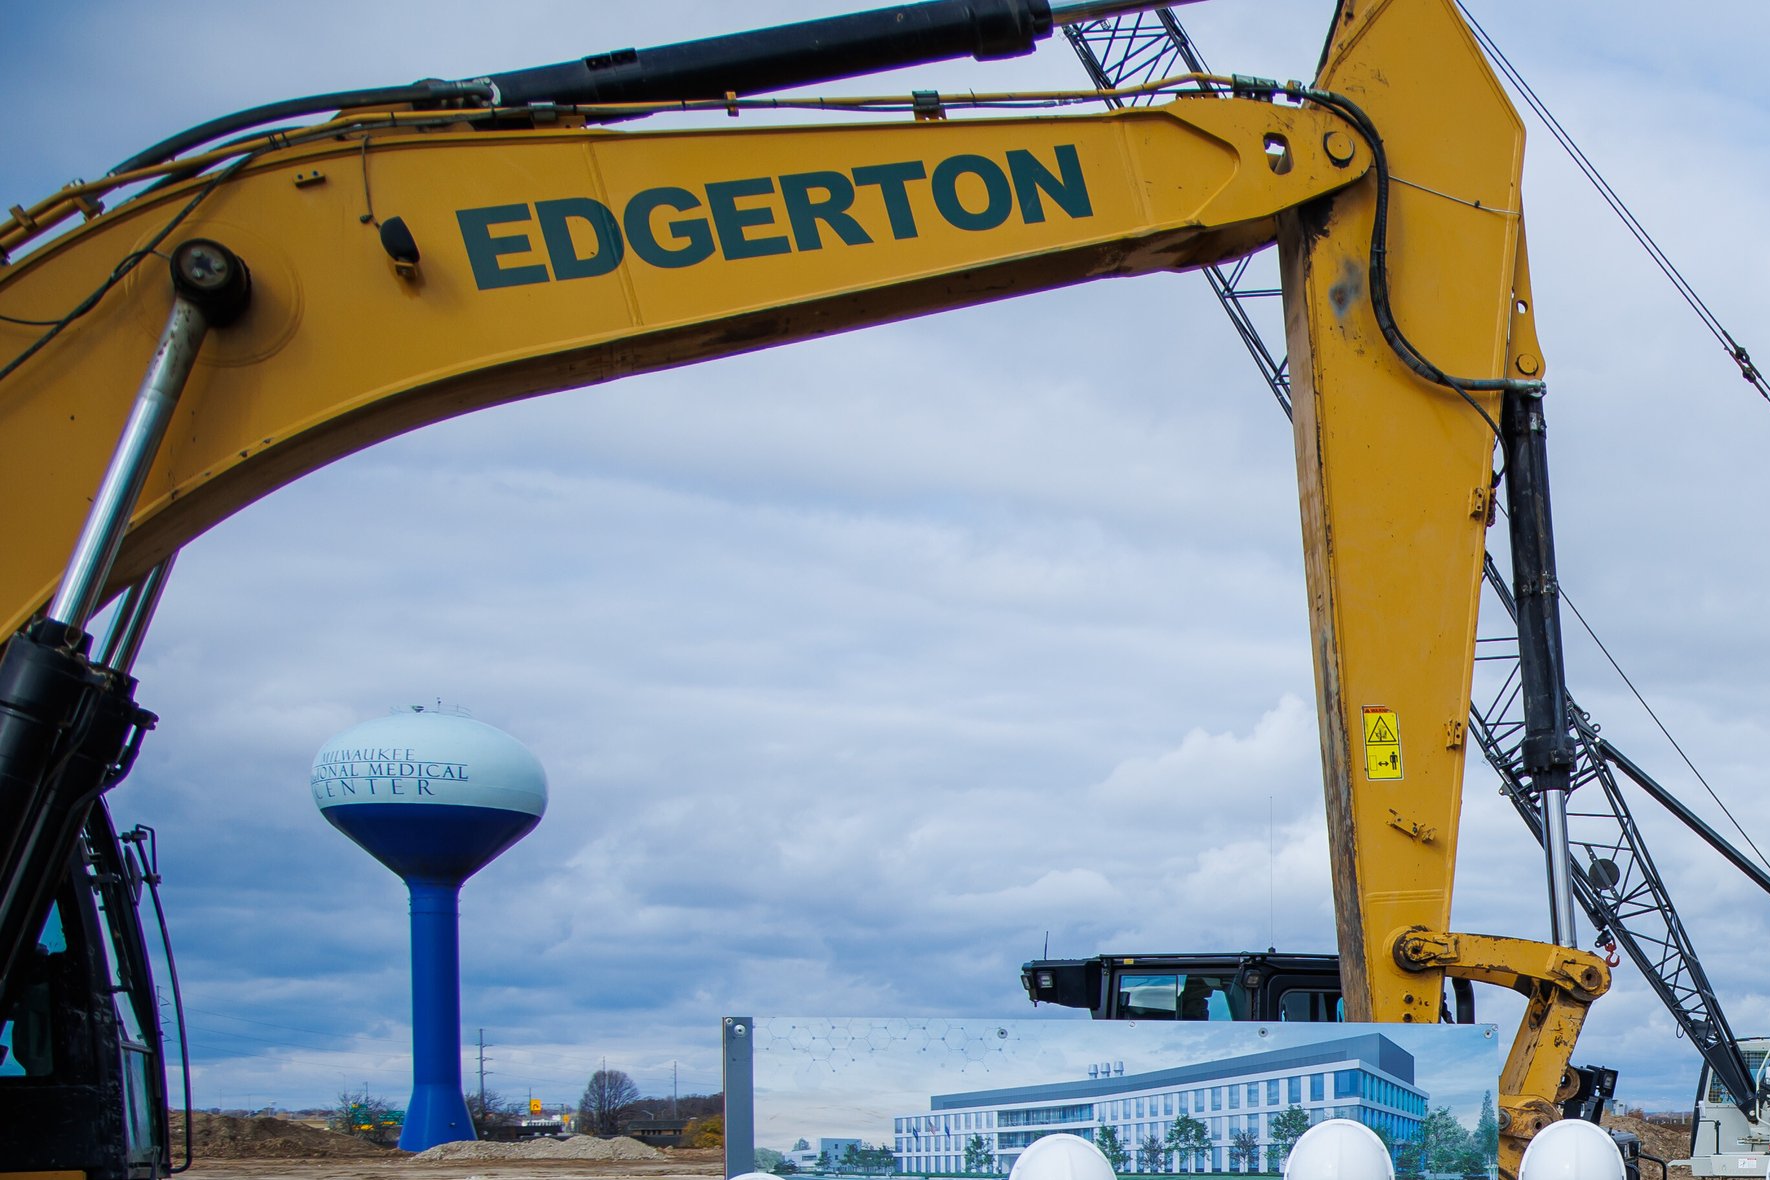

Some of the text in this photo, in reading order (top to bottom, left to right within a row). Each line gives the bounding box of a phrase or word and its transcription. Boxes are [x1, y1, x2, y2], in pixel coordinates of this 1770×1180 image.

[456, 144, 1094, 291] EDGERTON
[322, 748, 416, 763] MILWAUKEE
[369, 763, 469, 780] MEDICAL
[313, 779, 436, 800] CENTER
